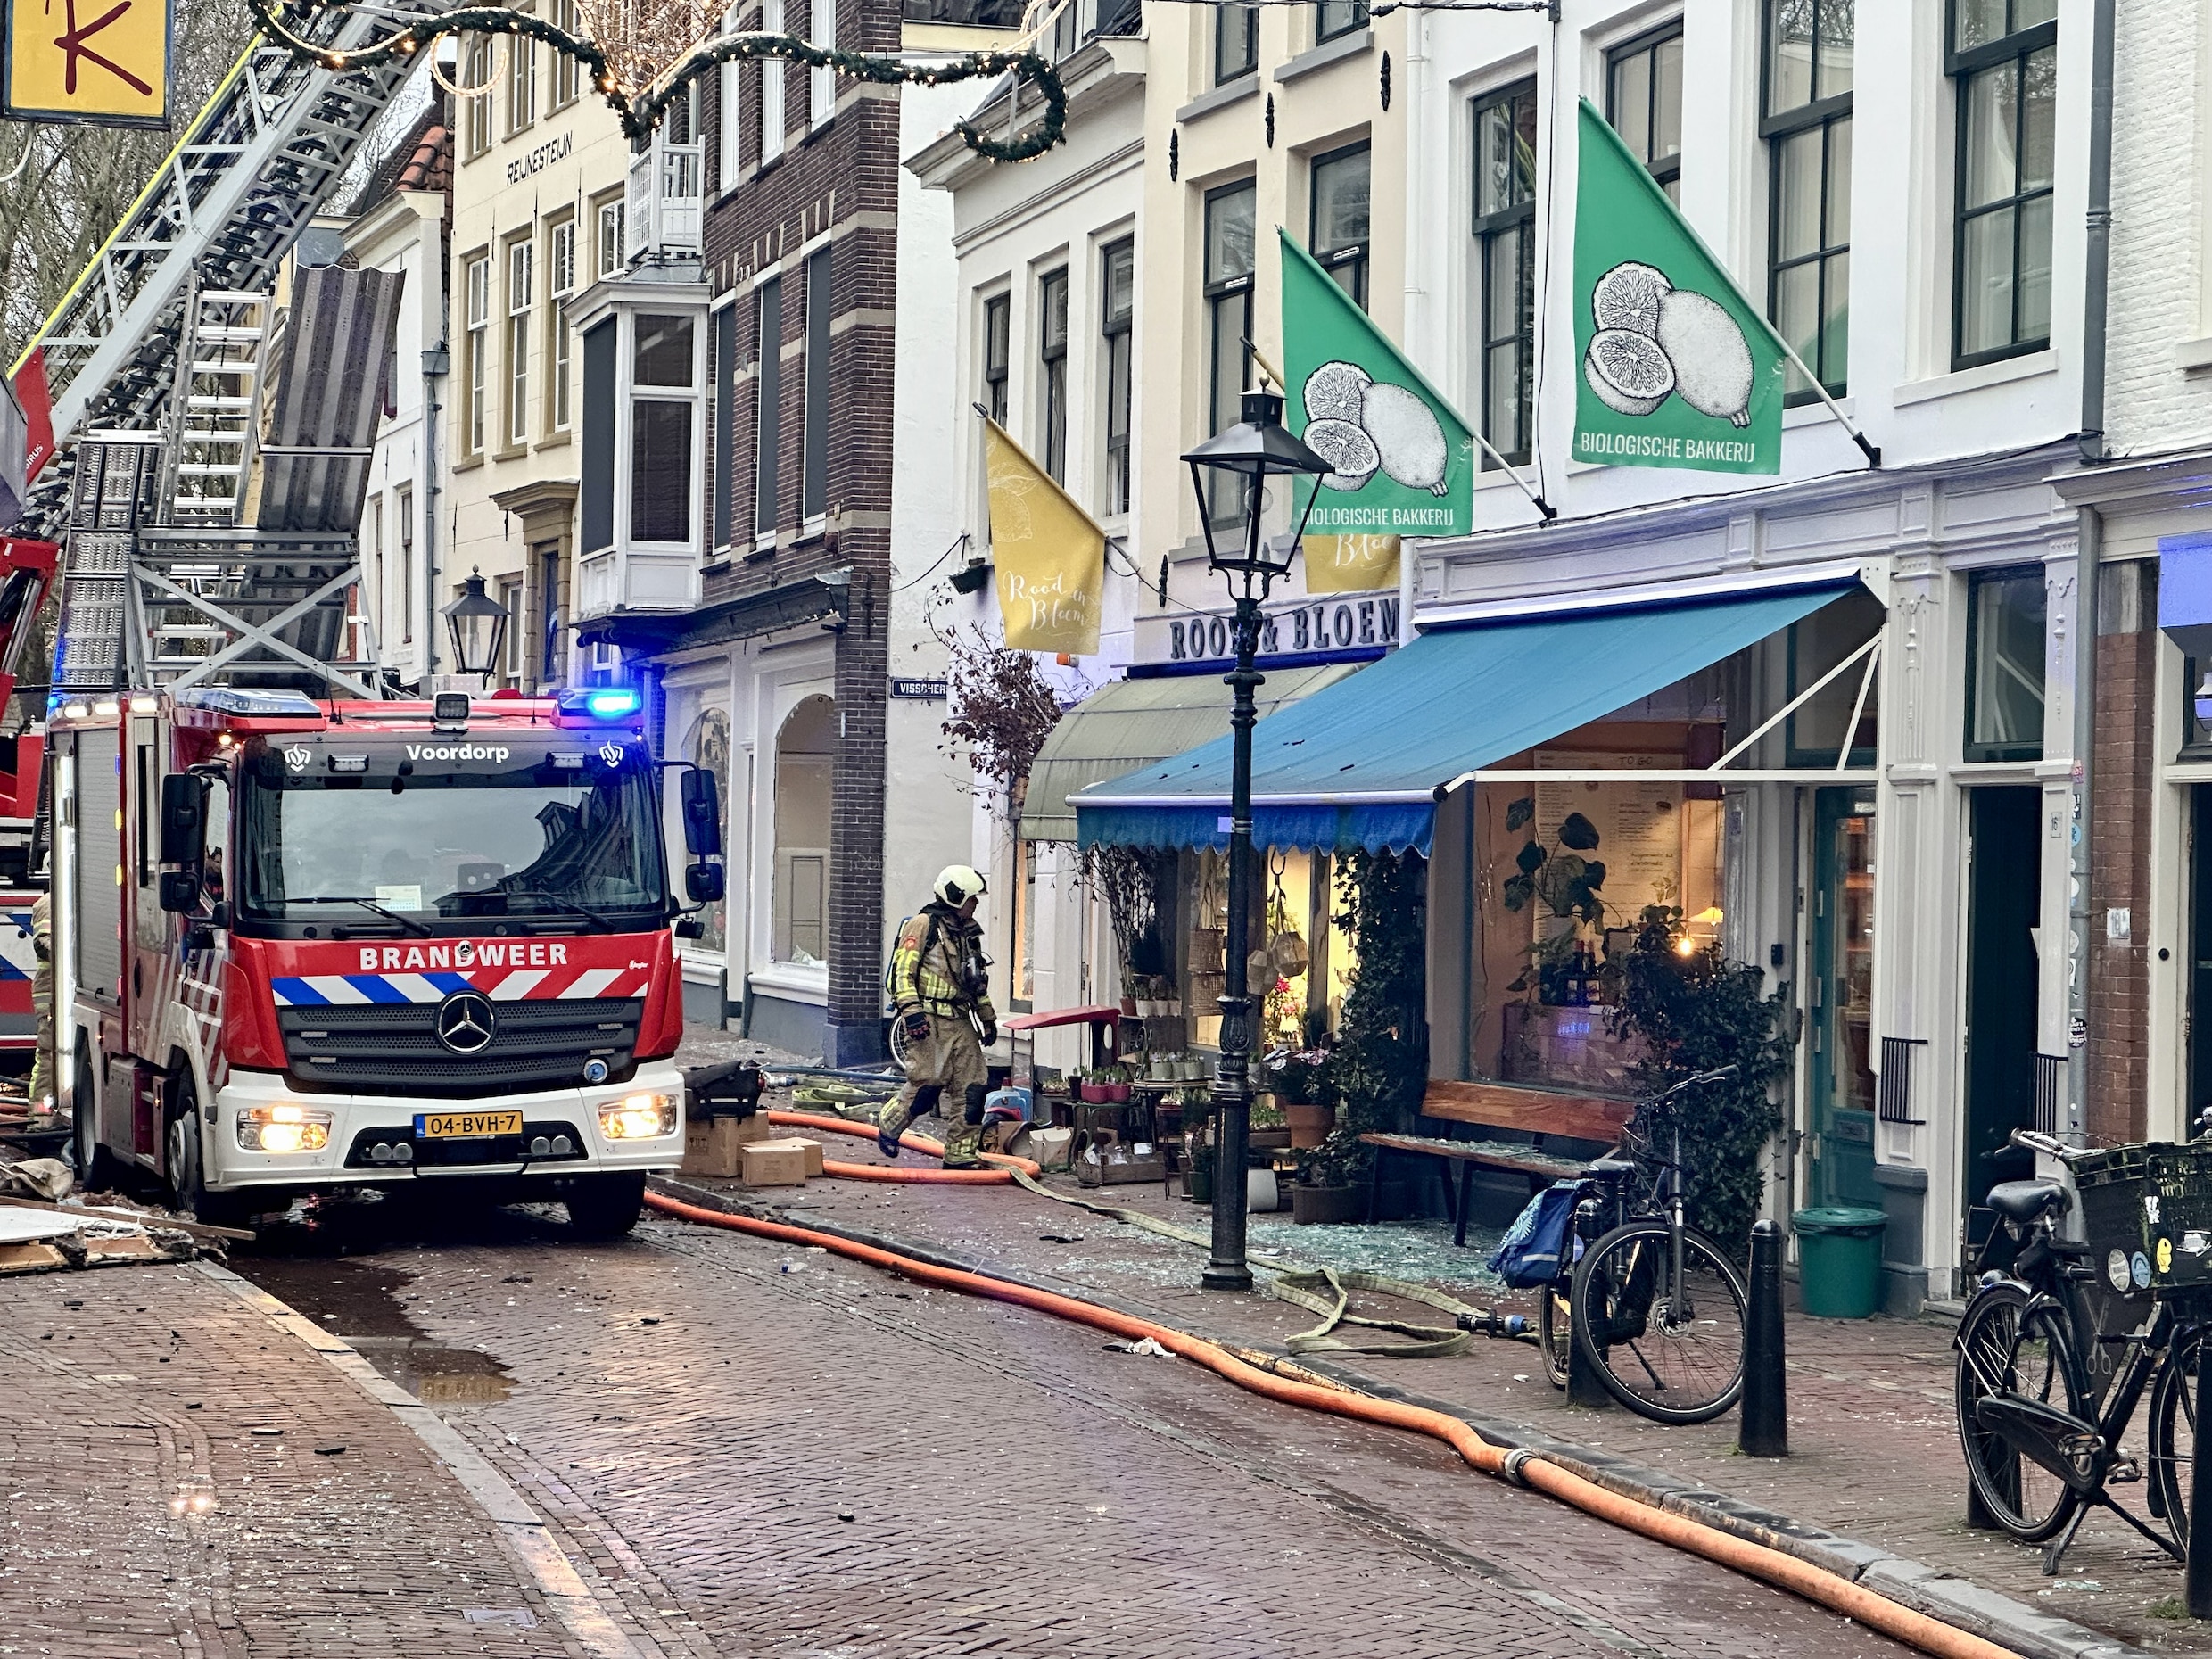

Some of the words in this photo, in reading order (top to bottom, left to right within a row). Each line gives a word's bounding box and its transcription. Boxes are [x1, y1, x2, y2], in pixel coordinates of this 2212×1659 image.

[507, 129, 573, 186] REIJNESTEIJN
[1581, 432, 1681, 458] BIOLOGISCHE
[1686, 439, 1755, 463] BAKKERIJ
[1392, 508, 1454, 526] BAKKERIJ
[1002, 570, 1068, 603] Rood
[1070, 589, 1085, 607] en
[1029, 596, 1089, 630] Bloem
[1169, 617, 1237, 659] ROO
[1262, 612, 1278, 652] &
[1292, 598, 1400, 649] BLOEM
[899, 681, 946, 695] VISSCHER
[405, 743, 510, 764] Voordorp
[359, 943, 568, 970] BRANDWEER
[430, 1115, 516, 1135] 04-BVH-7
